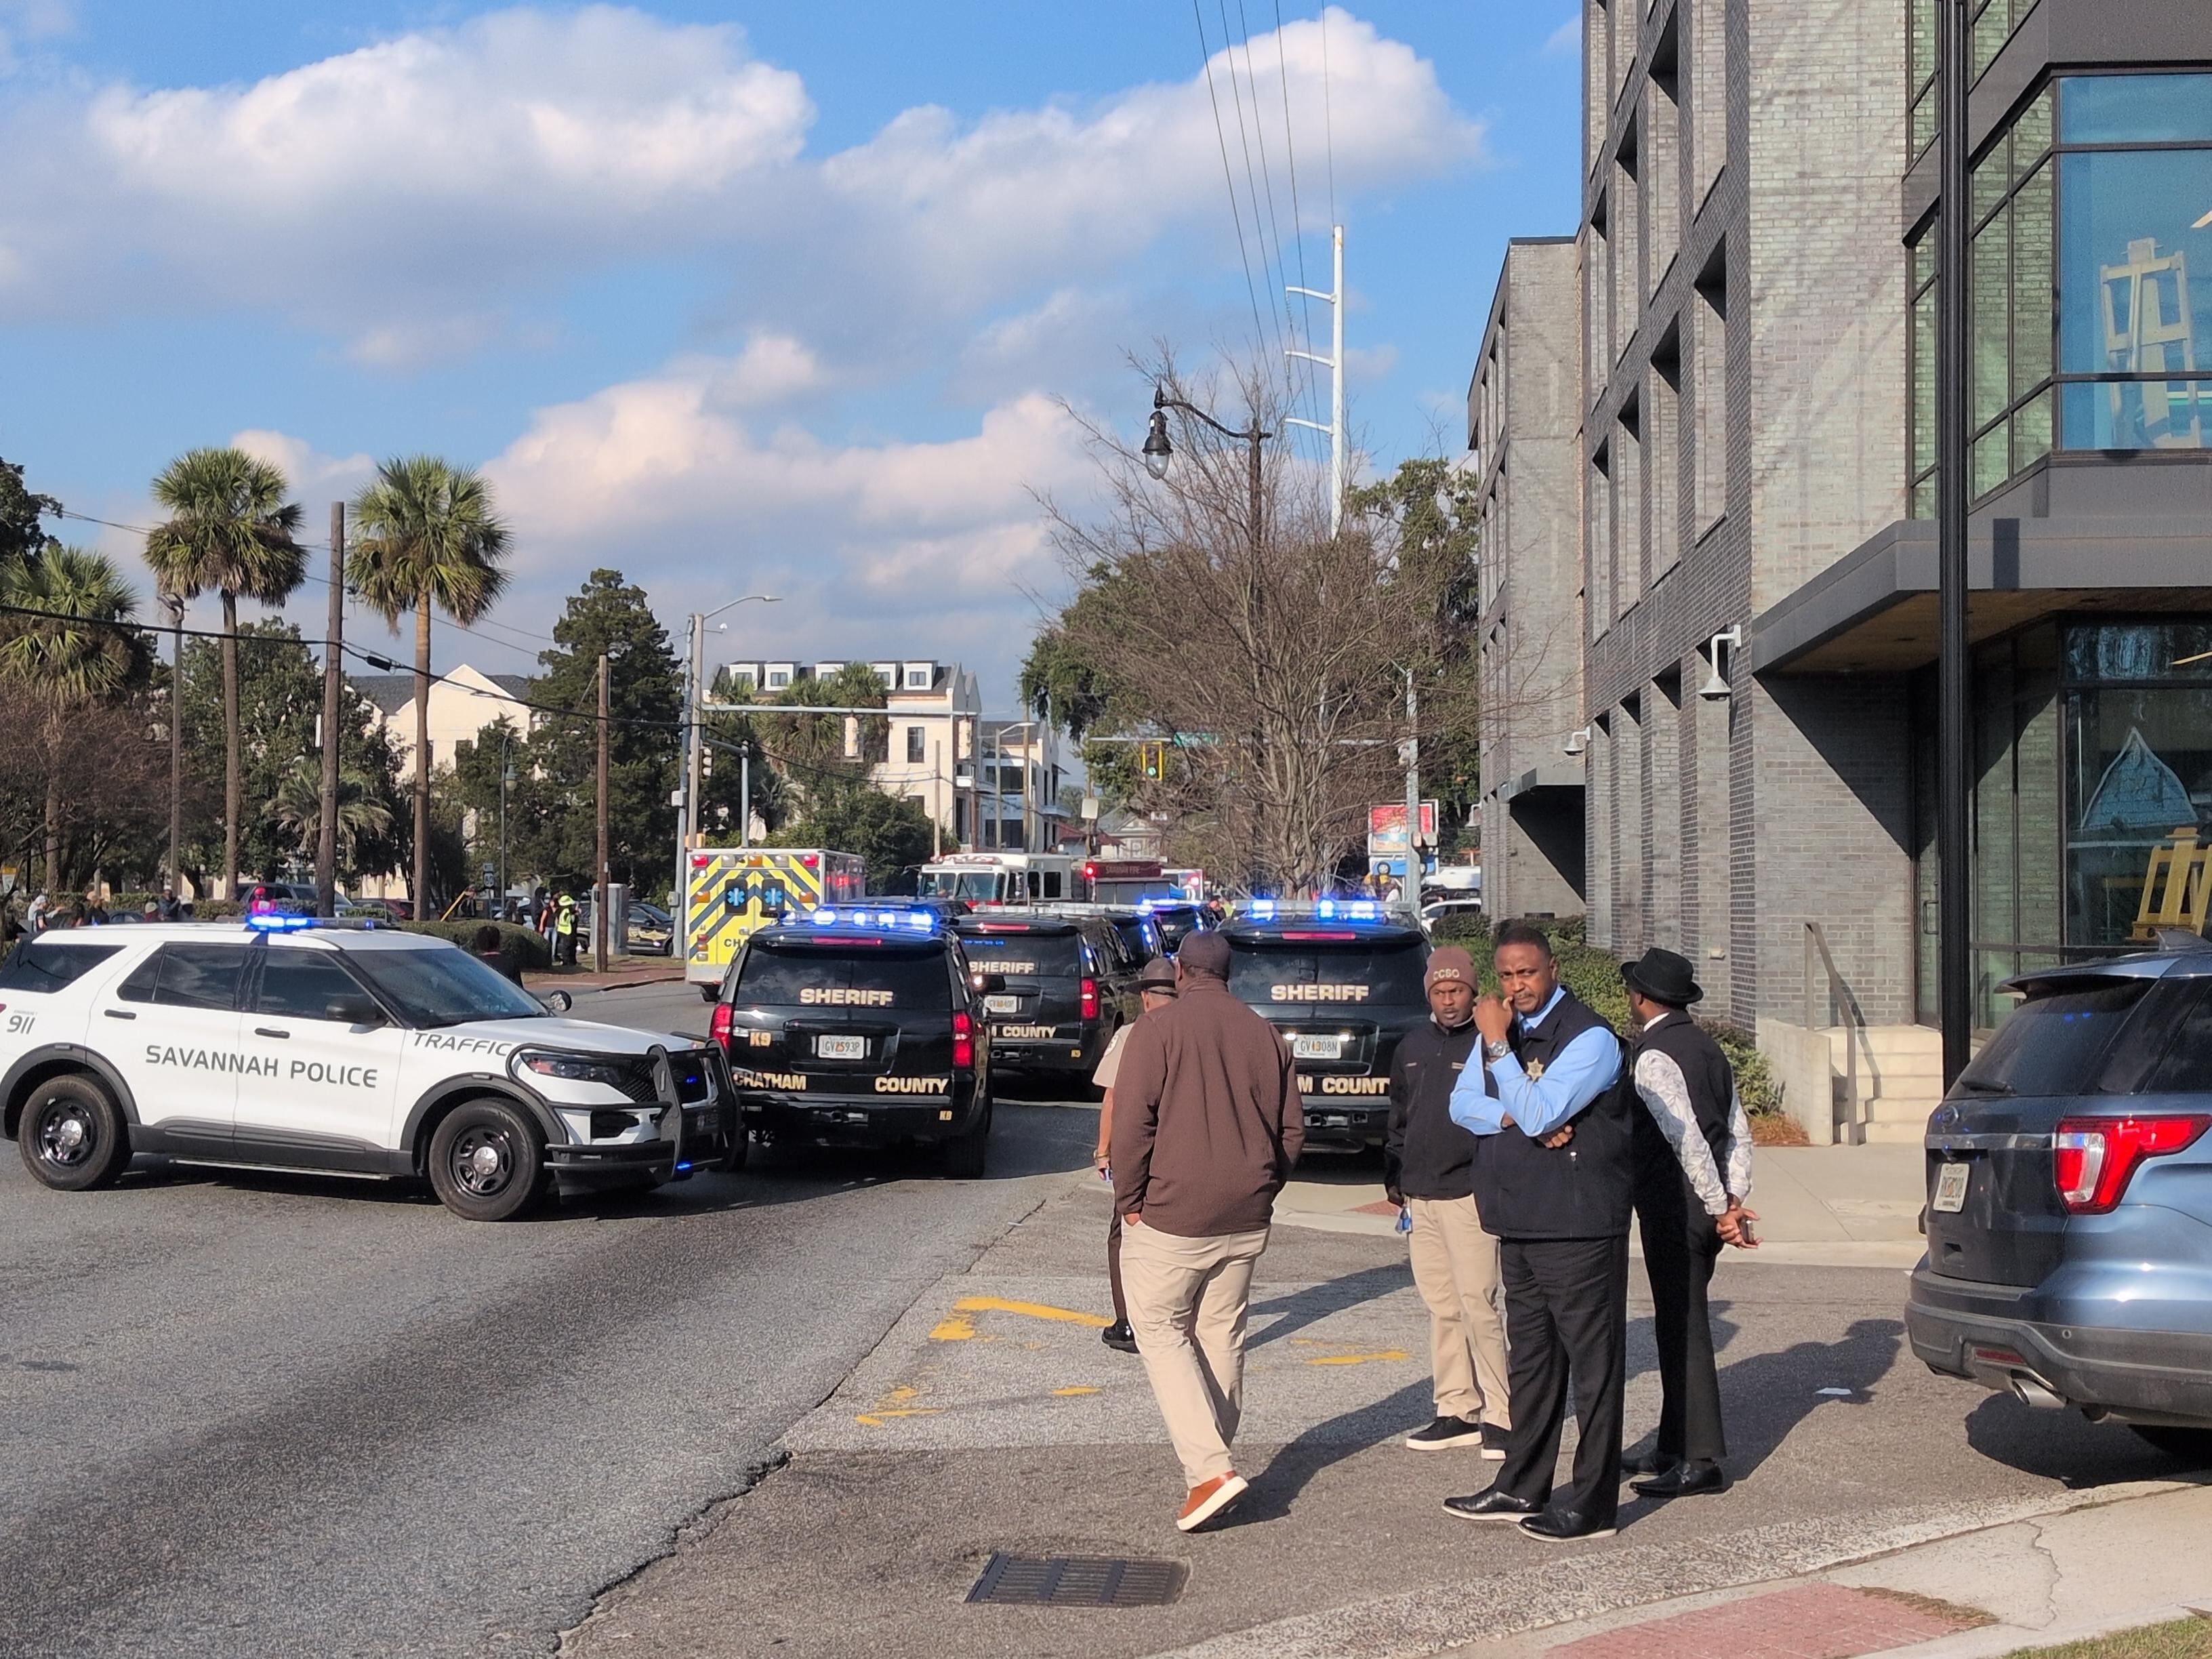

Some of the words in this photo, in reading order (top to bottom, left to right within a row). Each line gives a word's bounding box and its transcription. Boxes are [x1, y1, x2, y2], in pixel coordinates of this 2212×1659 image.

[968, 961, 1035, 974] SHERIFF
[800, 987, 894, 1006] SHERIFF
[1271, 984, 1369, 1001] SHERIFF
[7, 1015, 35, 1034] 911
[1002, 1025, 1057, 1038] COUNTY
[414, 1032, 512, 1057] TRAFFIC
[750, 1031, 771, 1047] K9
[146, 1044, 279, 1078] SAVANNAH
[289, 1060, 377, 1088] POLICE
[733, 1072, 806, 1090] CHATHAM
[875, 1077, 949, 1094] COUNTY
[1322, 1077, 1391, 1094] COUNT
